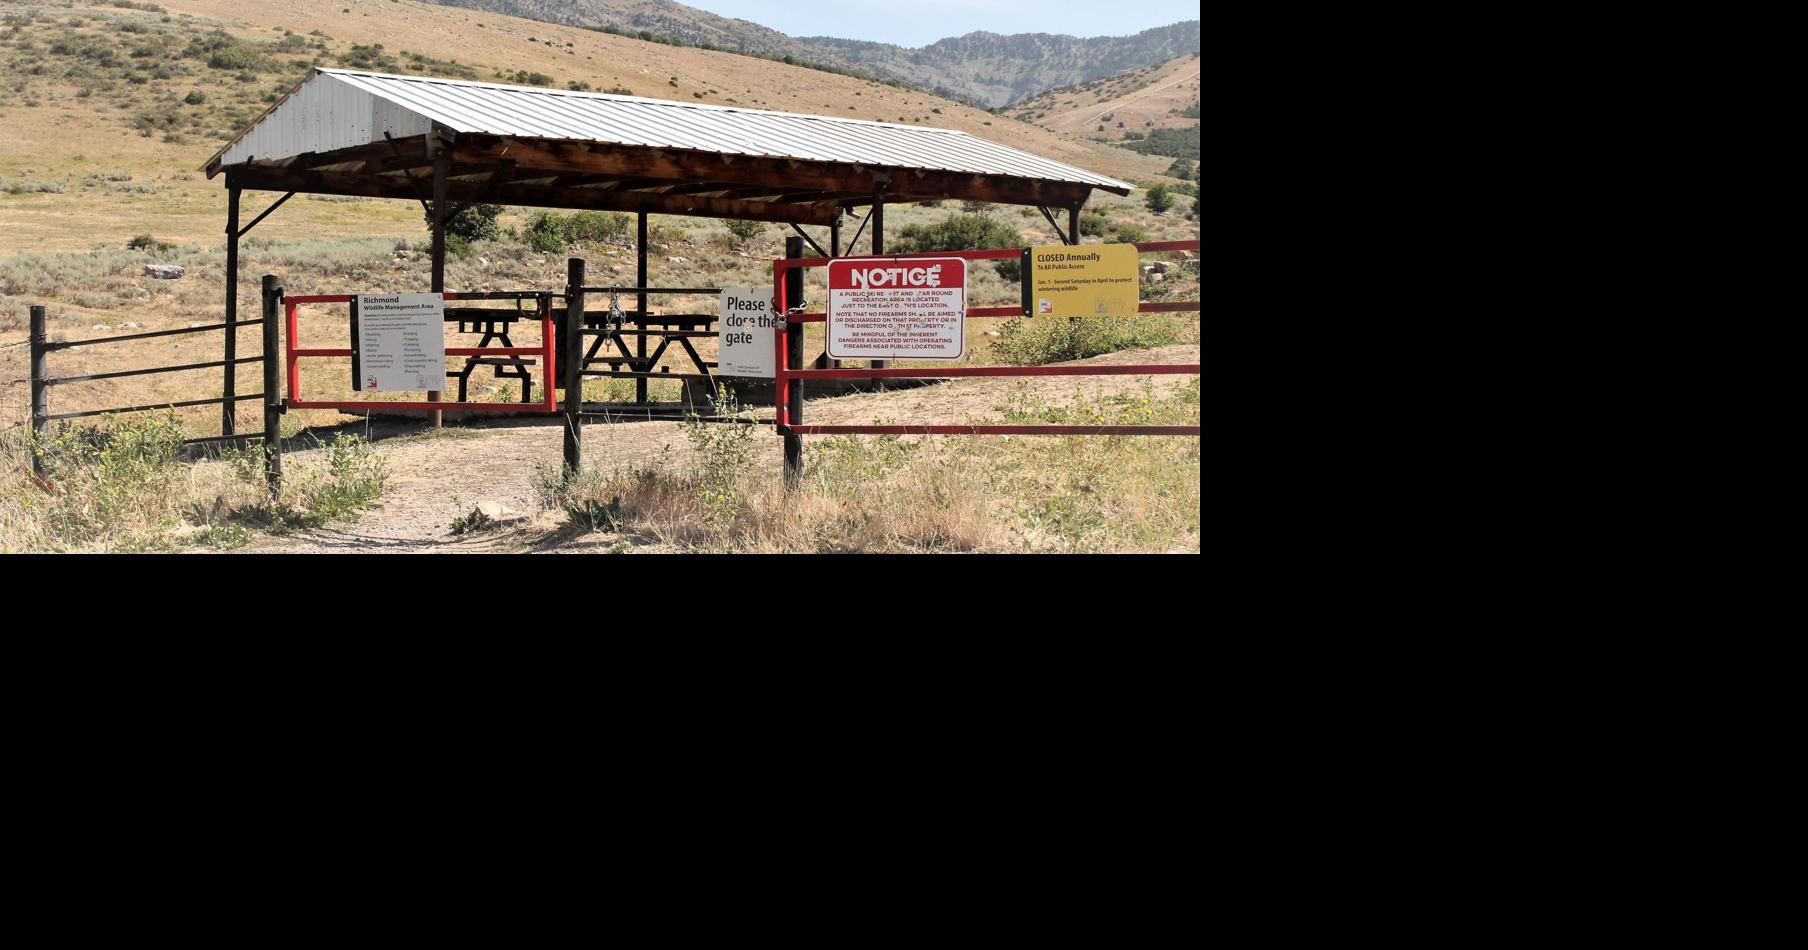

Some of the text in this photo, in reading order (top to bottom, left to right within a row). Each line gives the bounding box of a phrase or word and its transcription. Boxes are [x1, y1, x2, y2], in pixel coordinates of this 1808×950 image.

[1037, 252, 1100, 262] CLOSED Annually
[851, 266, 942, 287] NOTICE
[727, 296, 765, 310] Please
[726, 313, 755, 327] close
[726, 332, 753, 347] gate
